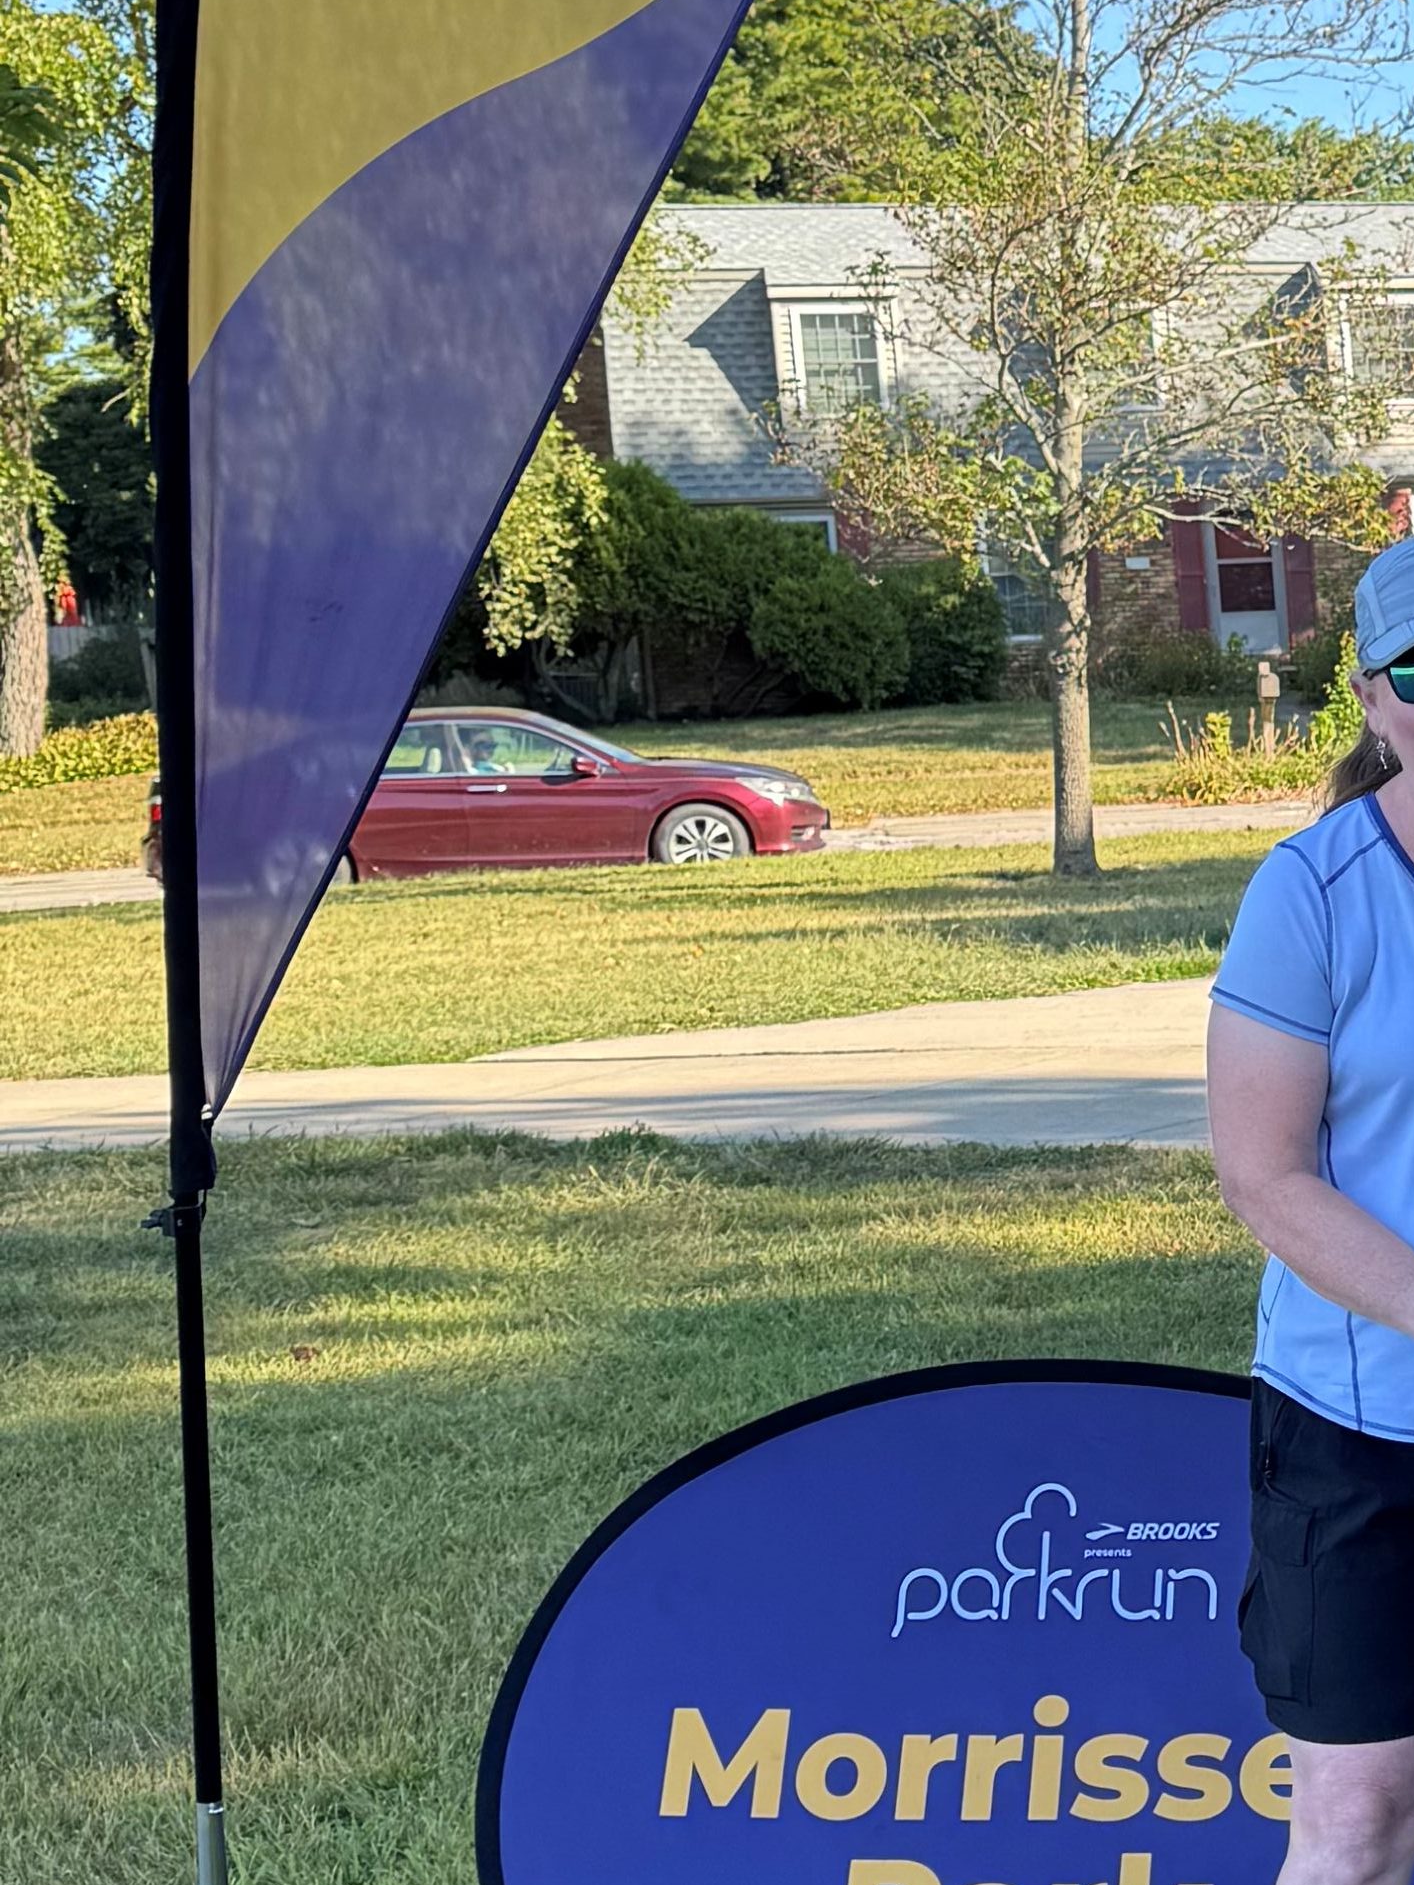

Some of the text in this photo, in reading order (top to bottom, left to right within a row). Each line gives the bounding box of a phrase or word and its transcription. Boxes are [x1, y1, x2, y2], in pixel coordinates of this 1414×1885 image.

[1084, 1548, 1132, 1559] presents
[1126, 1522, 1220, 1541] BROOKS
[891, 1530, 1217, 1639] parkrun
[660, 1695, 1296, 1823] Morrisse
